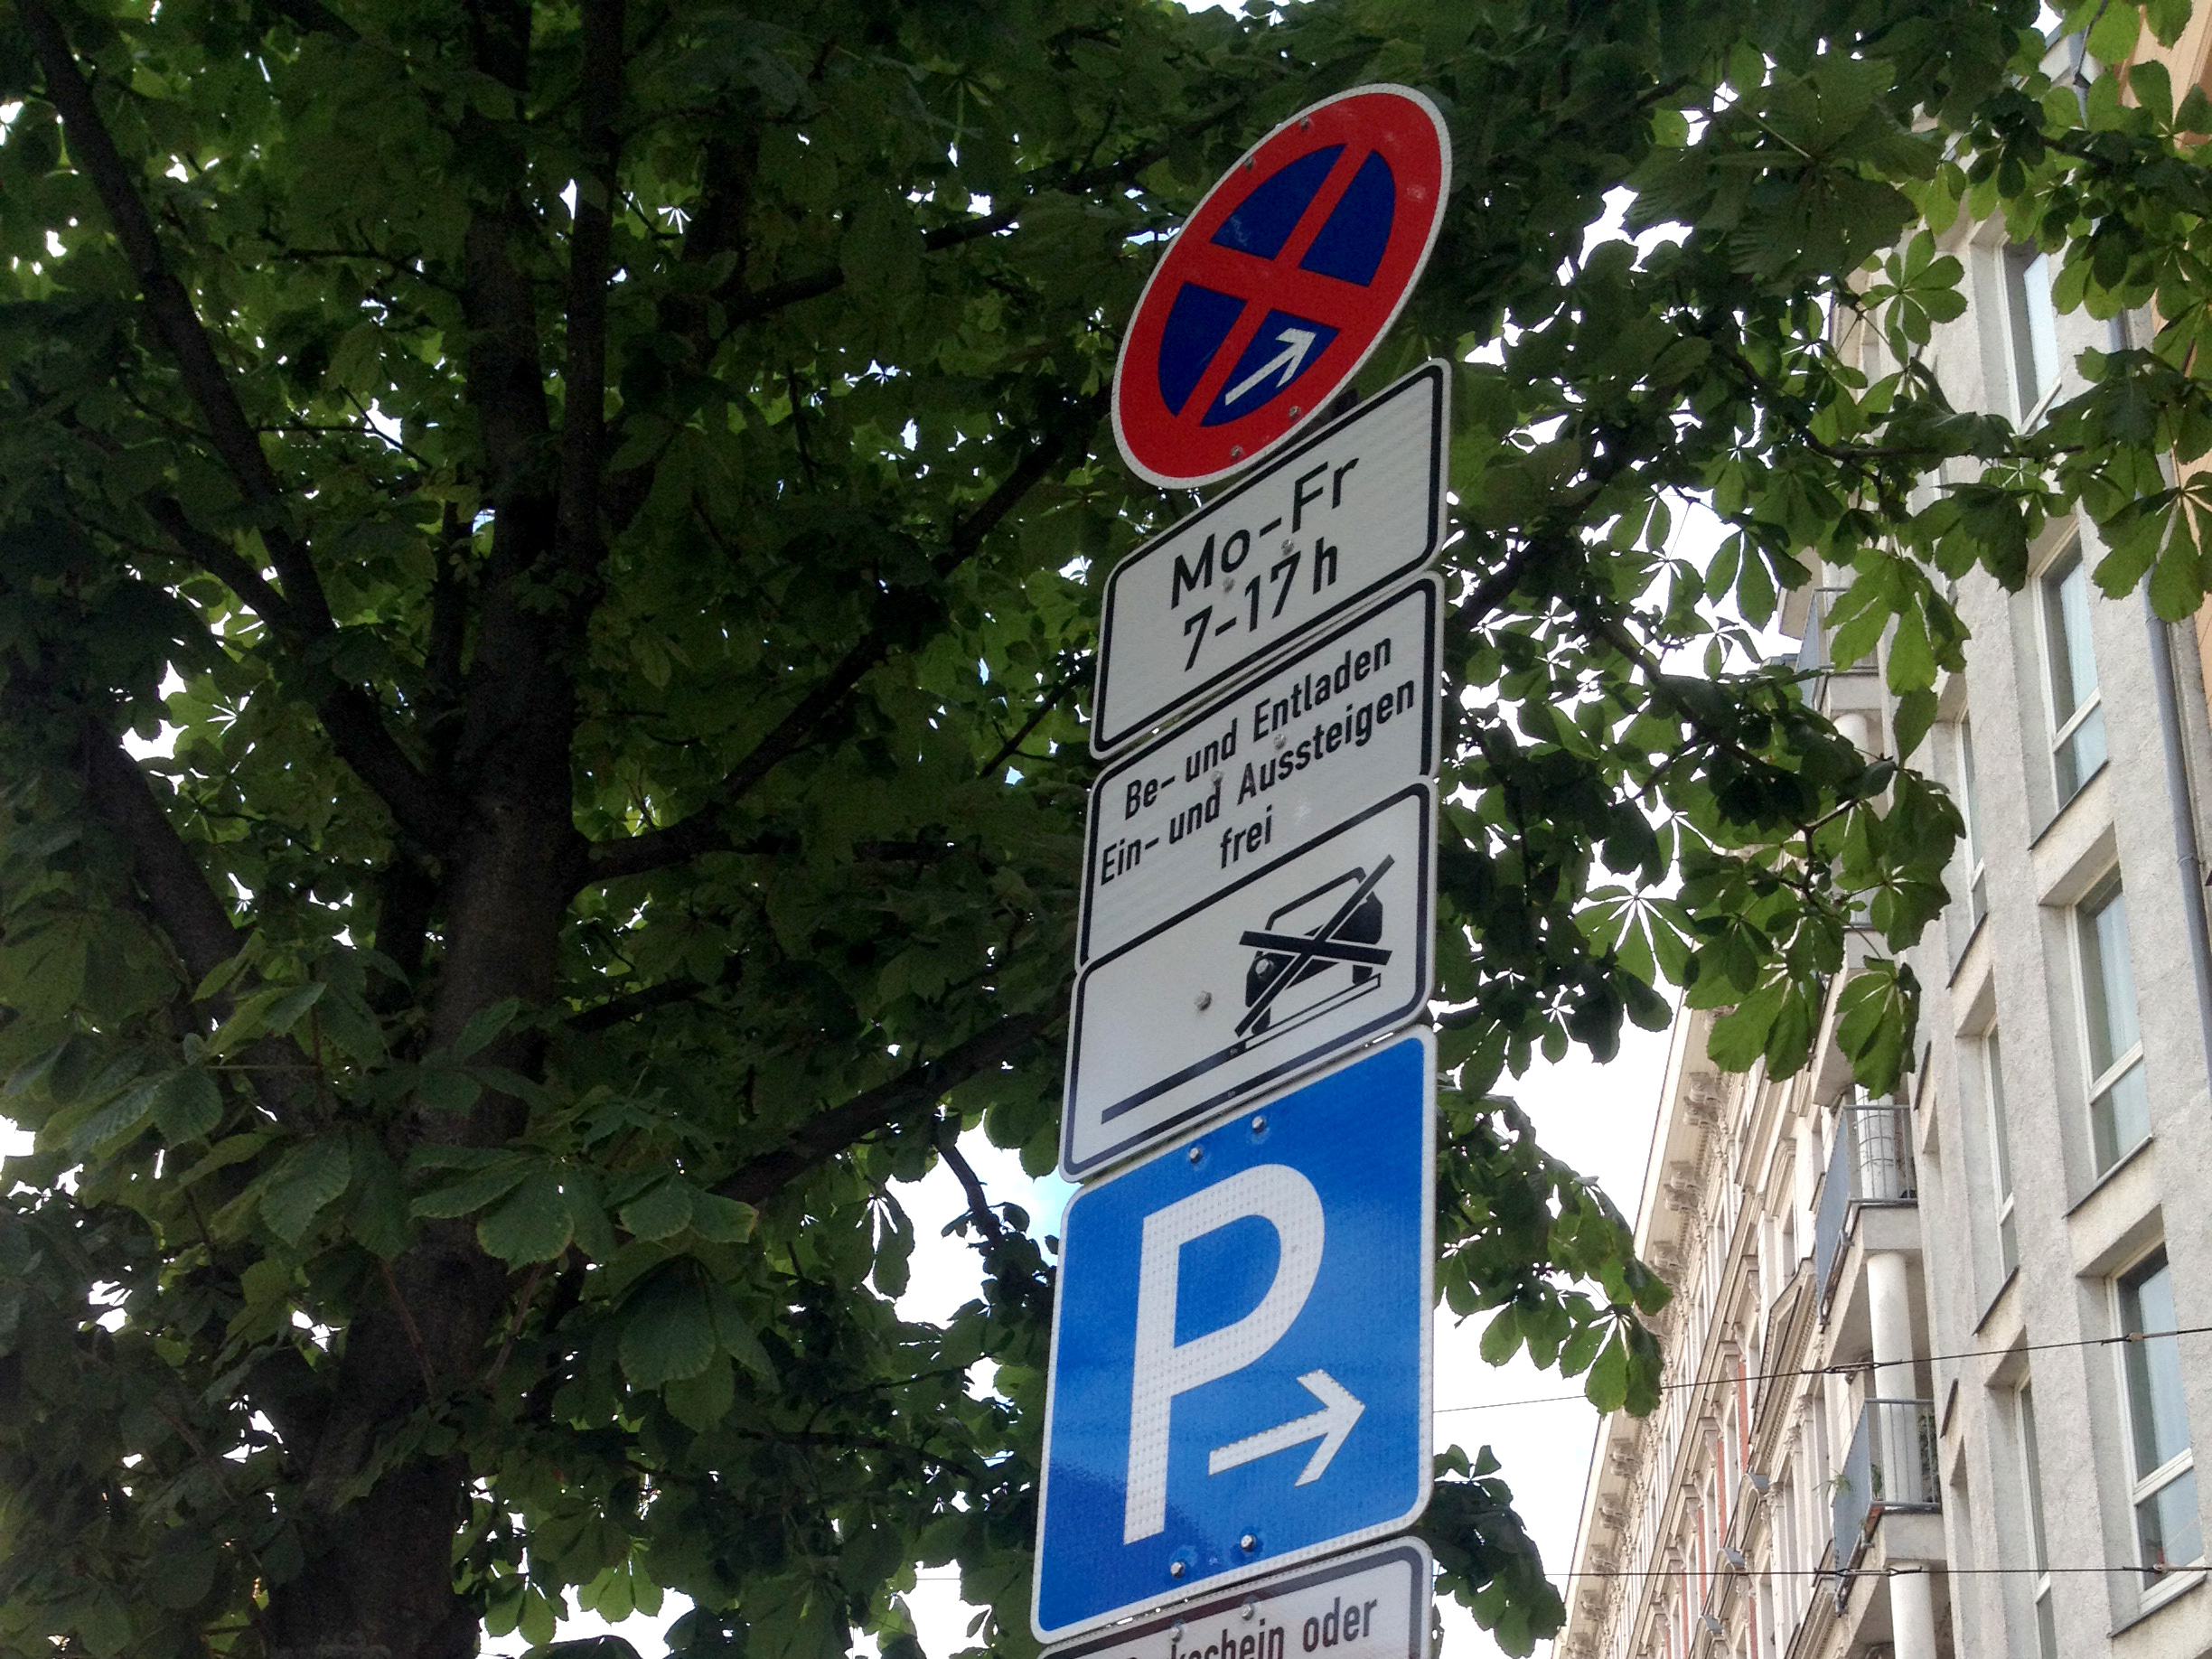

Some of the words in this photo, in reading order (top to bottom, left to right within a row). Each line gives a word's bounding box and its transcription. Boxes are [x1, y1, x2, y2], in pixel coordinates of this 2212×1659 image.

[1171, 457, 1359, 610] Mo-Fr
[1184, 550, 1301, 672] 7-17
[1312, 537, 1338, 595] h
[1100, 837, 1160, 886] Ein-
[1168, 783, 1221, 845] und
[1237, 680, 1414, 805] Aussteigen
[1124, 774, 1176, 820] Be-
[1186, 718, 1238, 783] und
[1252, 637, 1392, 743] Entladen
[1220, 805, 1272, 869] frei
[1123, 1162, 1325, 1545] P
[1303, 1596, 1378, 1654] oder
